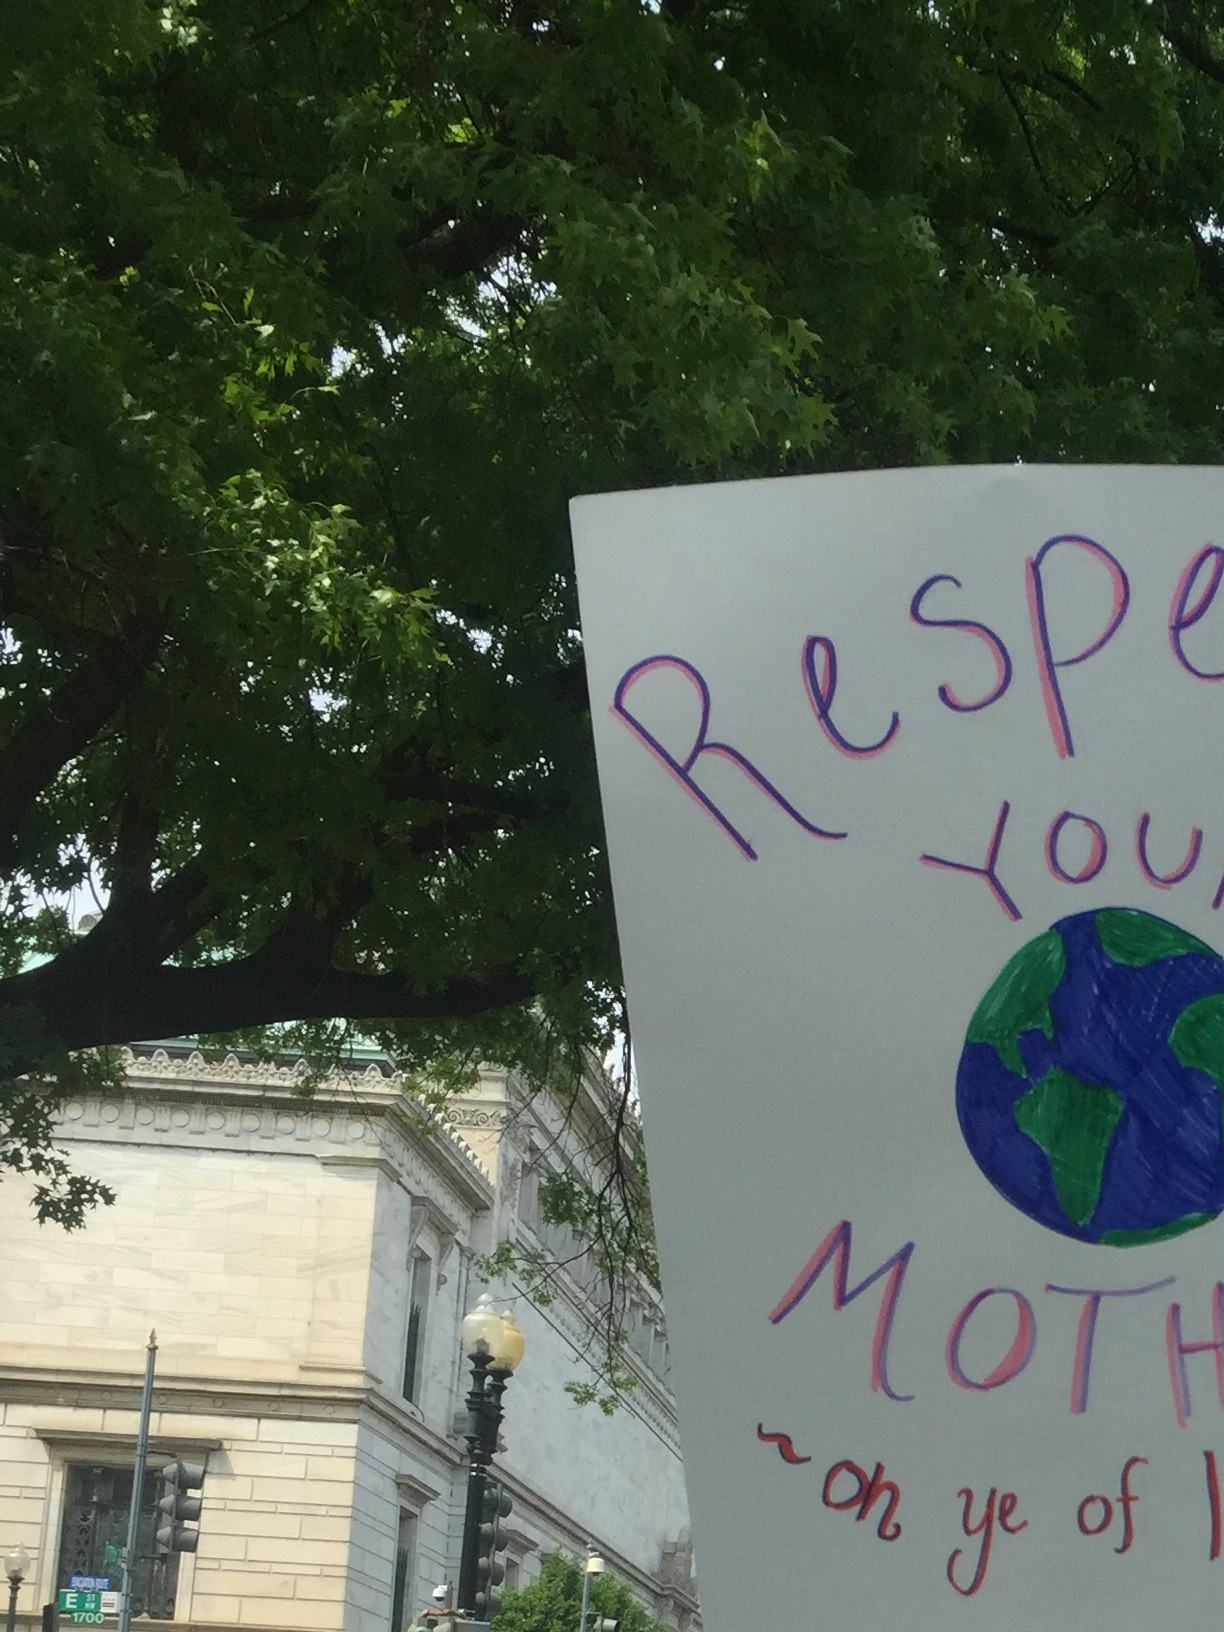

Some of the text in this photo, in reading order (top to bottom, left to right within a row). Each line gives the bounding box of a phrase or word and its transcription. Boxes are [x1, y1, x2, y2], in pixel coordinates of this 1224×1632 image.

[947, 1484, 1029, 1597] ye
[1076, 1456, 1149, 1554] of
[65, 1593, 78, 1608] E
[73, 1612, 105, 1623] 1700
